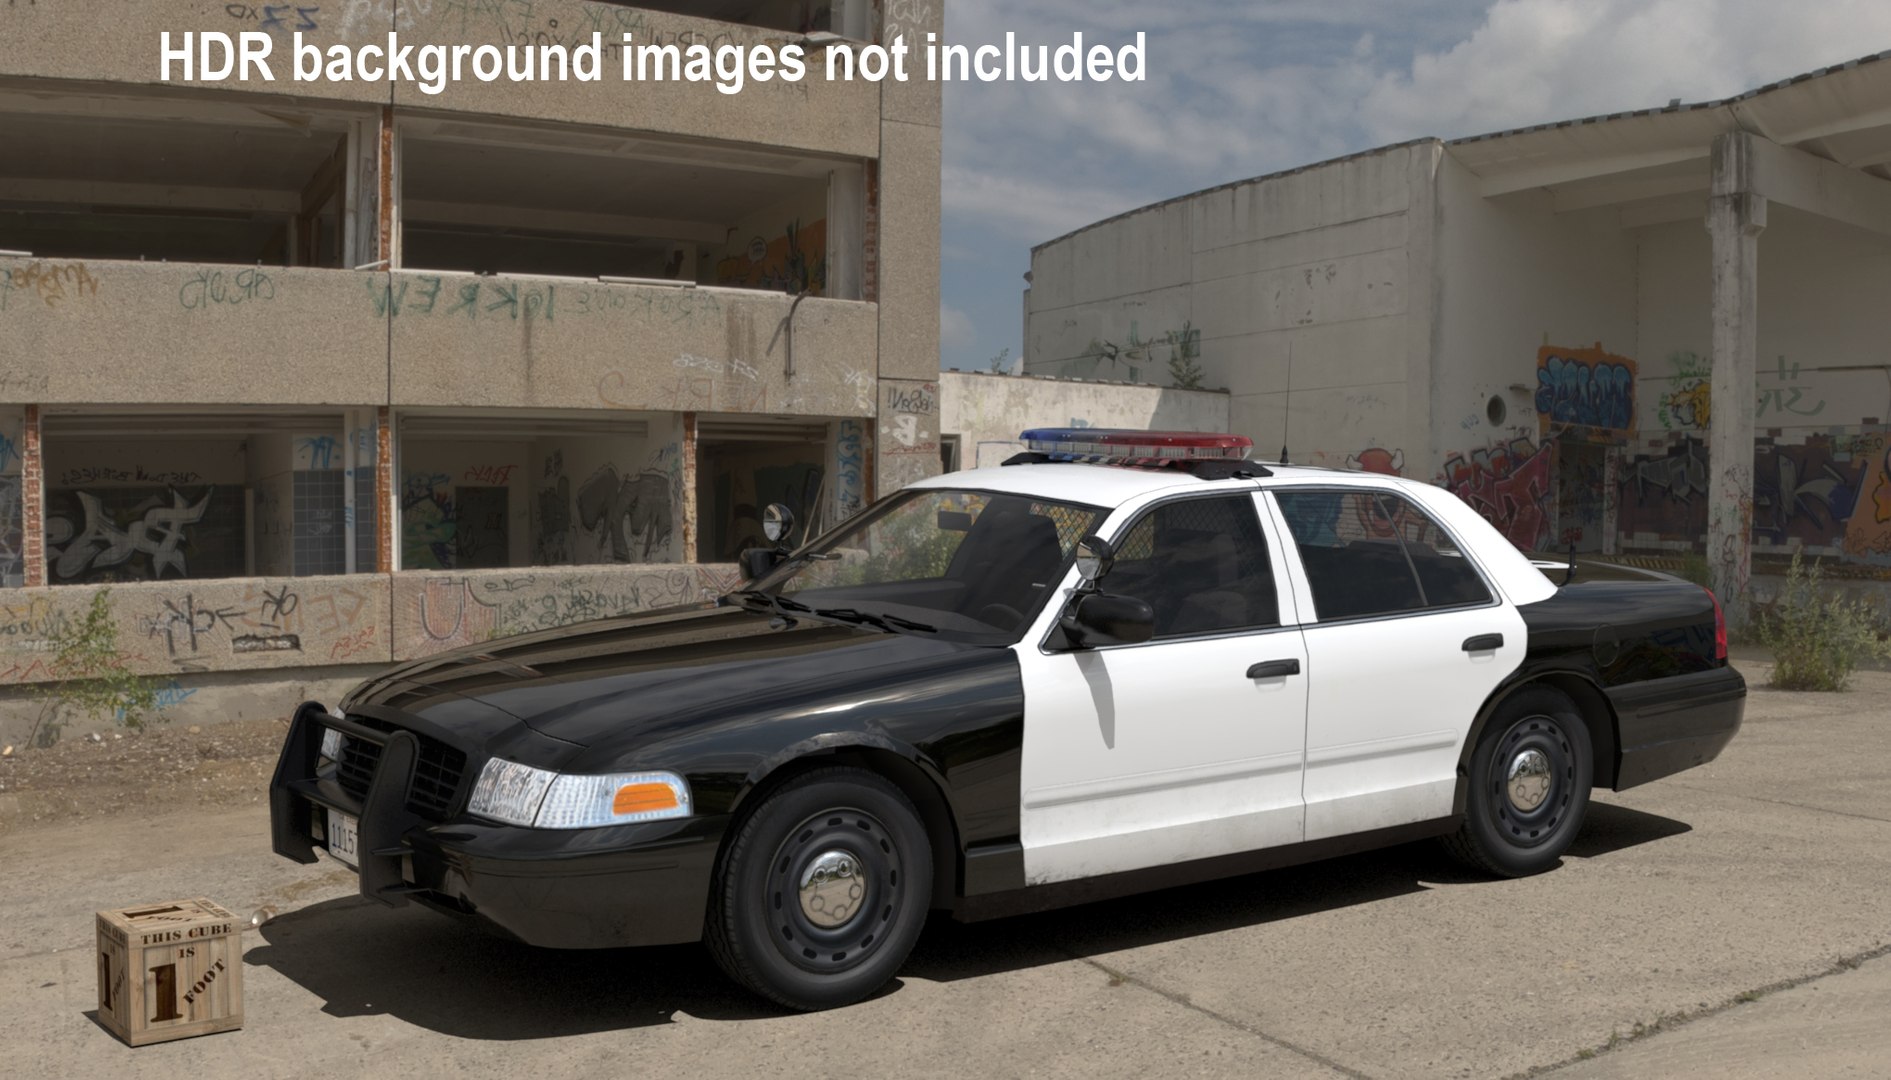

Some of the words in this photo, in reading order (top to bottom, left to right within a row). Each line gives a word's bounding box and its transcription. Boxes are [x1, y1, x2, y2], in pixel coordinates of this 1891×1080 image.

[332, 823, 358, 855] 1115
[140, 930, 182, 945] THIS
[188, 923, 232, 938] CUBE
[178, 946, 195, 959] IS
[148, 963, 183, 1023] 1
[183, 958, 225, 1006] FOOT
